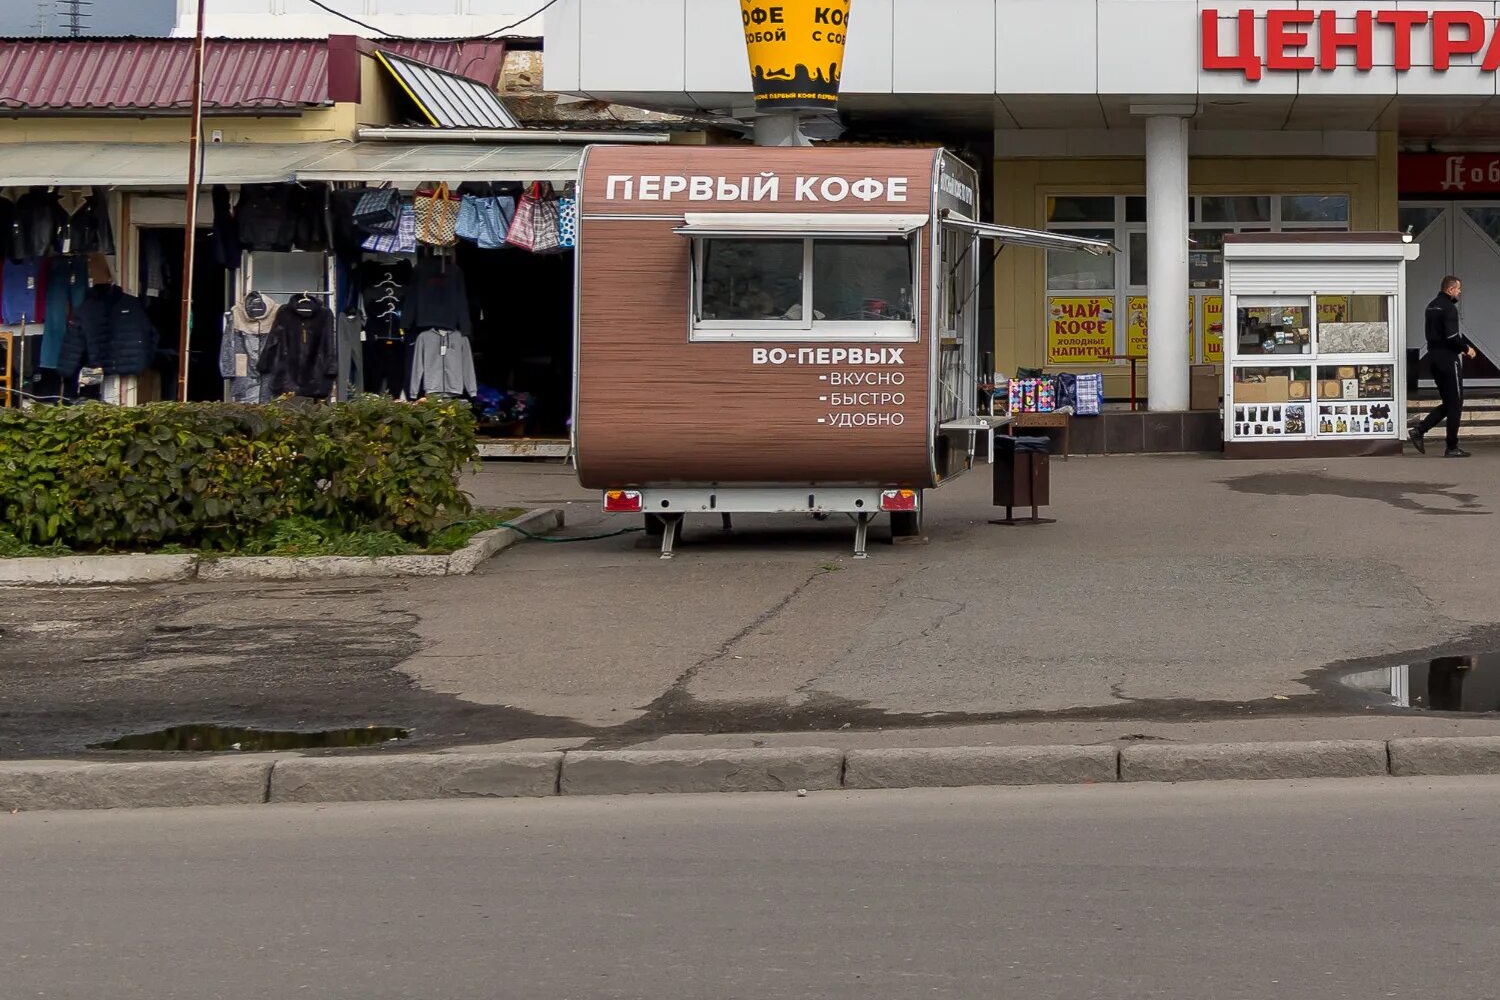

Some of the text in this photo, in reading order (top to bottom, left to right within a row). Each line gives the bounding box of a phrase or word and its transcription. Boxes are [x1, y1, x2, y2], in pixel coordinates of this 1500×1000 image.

[742, 7, 784, 26] ОФЕ
[814, 7, 849, 28] КО
[812, 30, 822, 42] С
[606, 171, 779, 201] ПЕРВЫЙ
[794, 176, 908, 202] КОФЕ
[1061, 300, 1101, 318] ЧАЙ
[1055, 320, 1108, 335] КОФЕ
[752, 347, 905, 365] ВО-ПЕРВЫХ
[1052, 347, 1111, 357] НАПИТКИ
